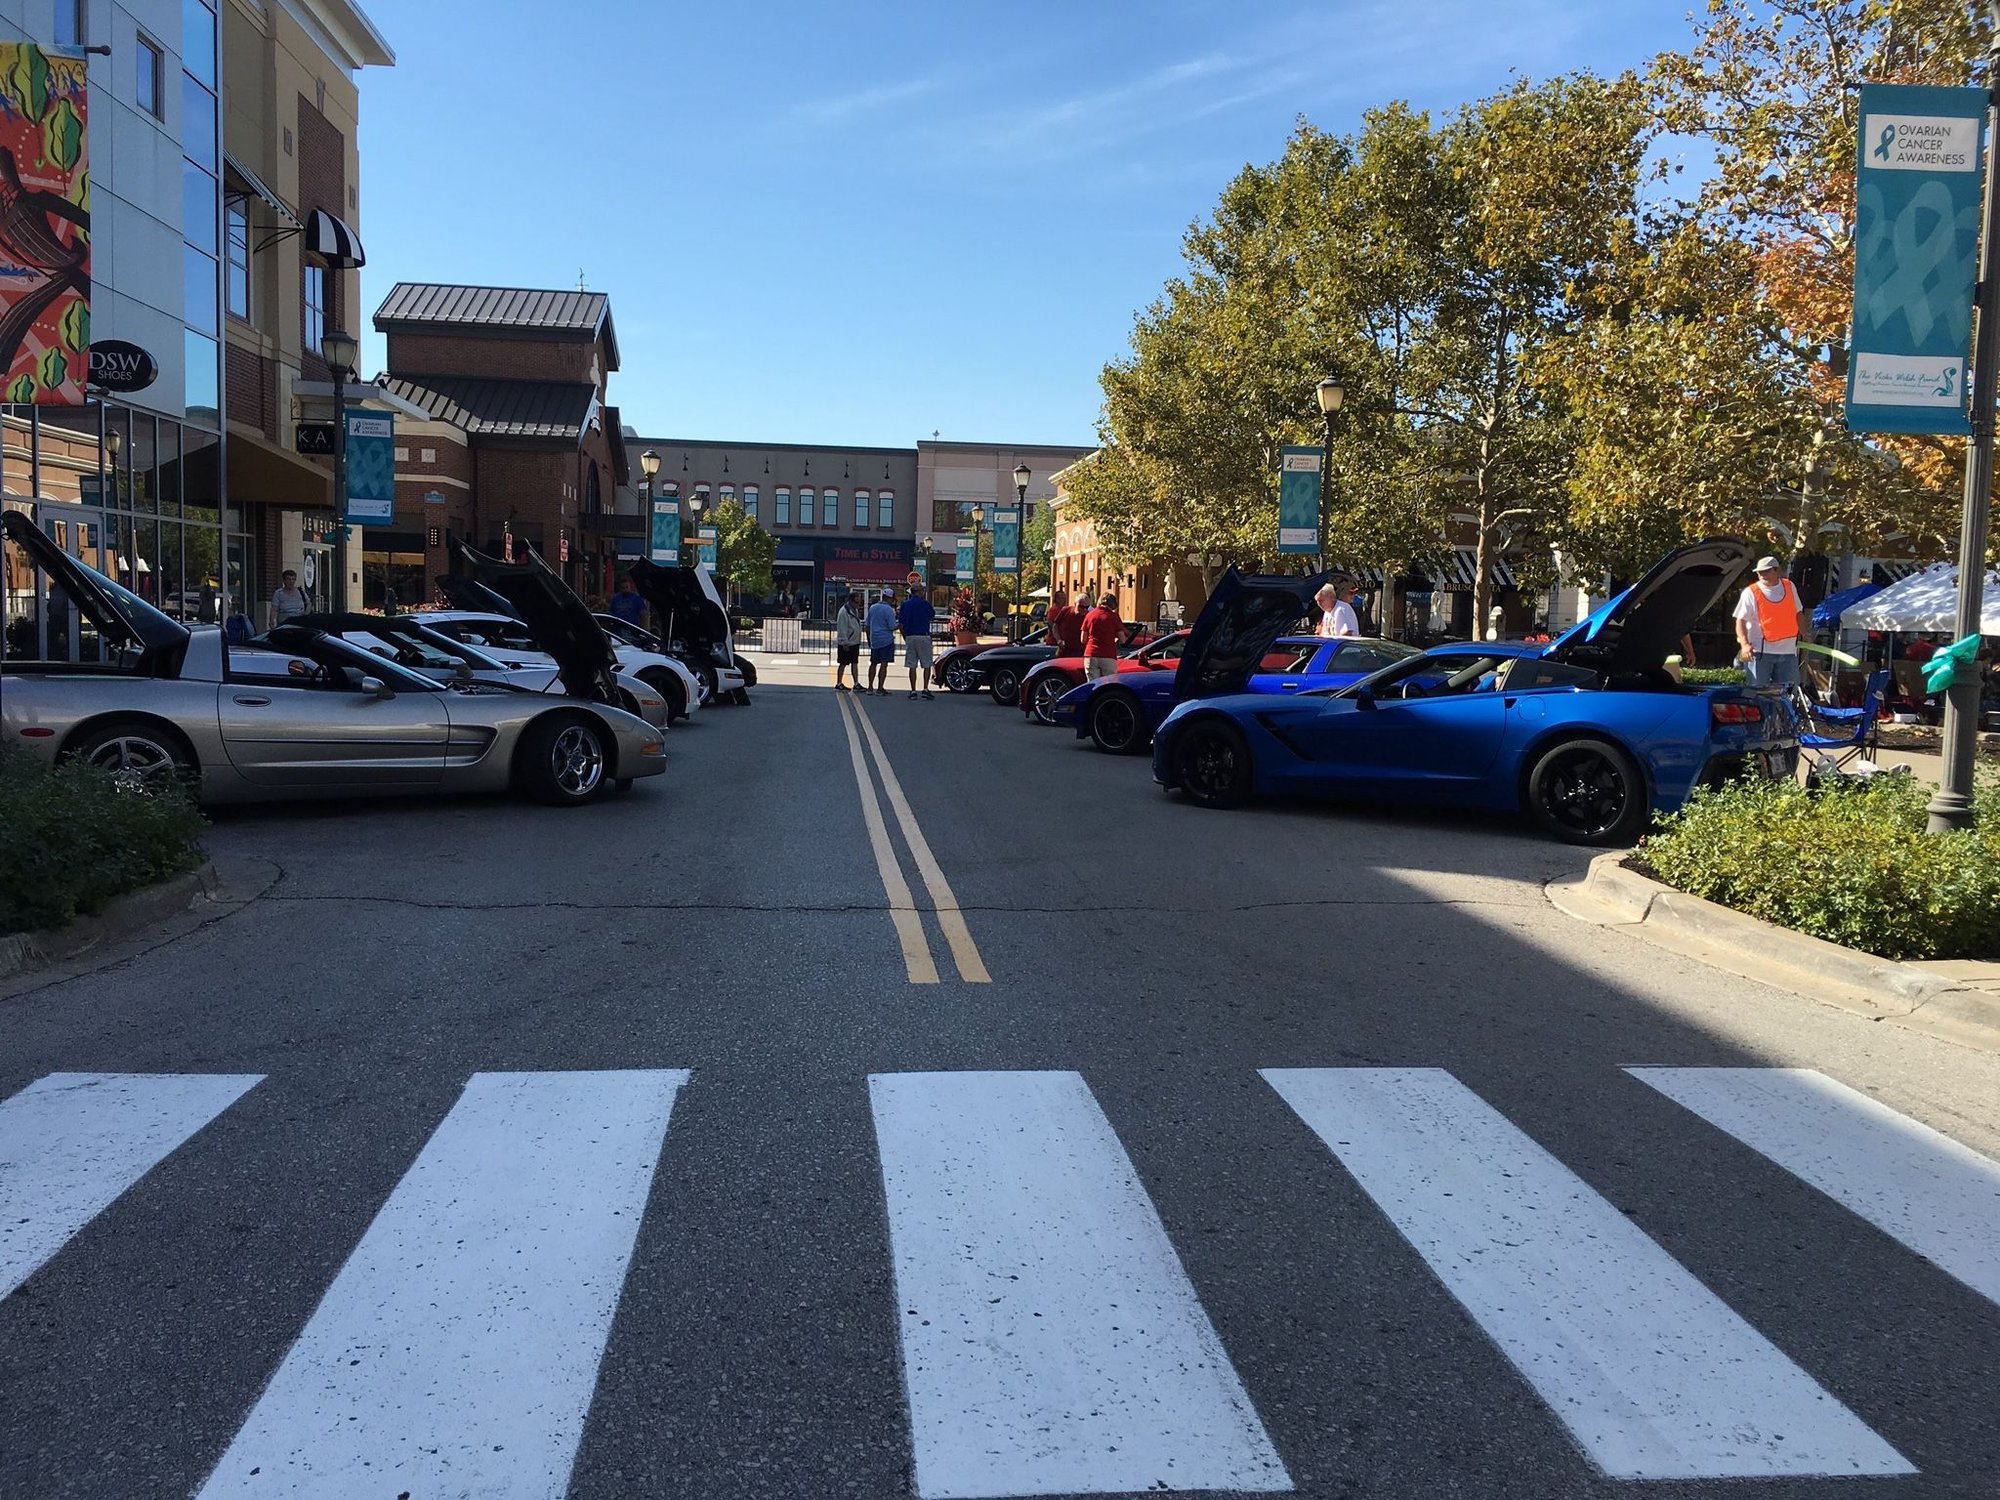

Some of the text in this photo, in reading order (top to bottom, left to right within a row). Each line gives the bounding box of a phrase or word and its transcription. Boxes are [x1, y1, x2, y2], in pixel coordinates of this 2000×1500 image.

[1898, 124, 1951, 137] OVARIAN
[1897, 138, 1943, 150] CANCER
[1896, 152, 1966, 165] AWARENESS
[89, 351, 142, 371] DSW
[98, 370, 132, 381] SHOES
[298, 430, 327, 443] KA
[833, 547, 861, 559] TIME
[871, 548, 902, 560] STYLE
